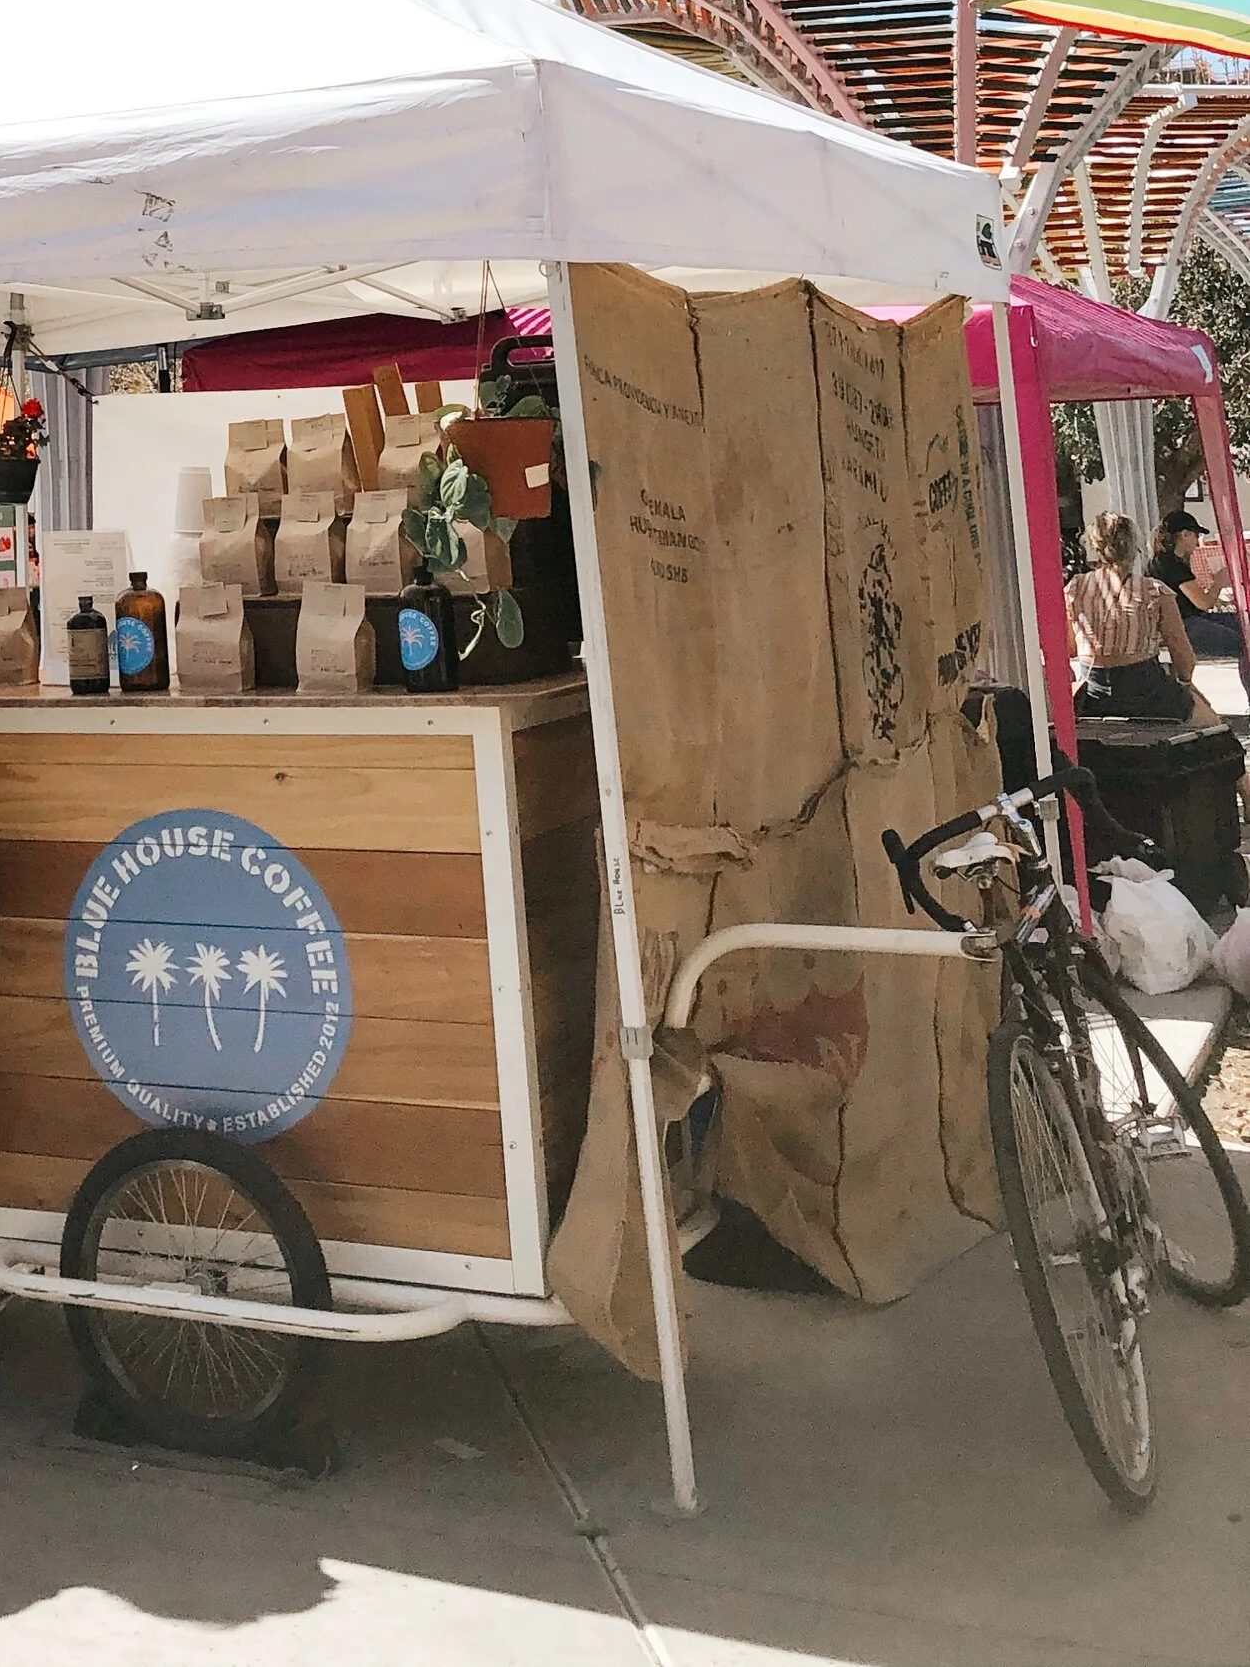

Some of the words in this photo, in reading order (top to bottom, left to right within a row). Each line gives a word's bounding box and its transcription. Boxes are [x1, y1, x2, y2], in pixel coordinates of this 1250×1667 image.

[75, 875, 121, 979] BLUE
[111, 825, 235, 885] HOUSE
[241, 844, 339, 995] COFFEE
[76, 985, 126, 1080] PREMIUM
[125, 1077, 205, 1131] QUALITY
[222, 1046, 327, 1133] ESTABLISHED
